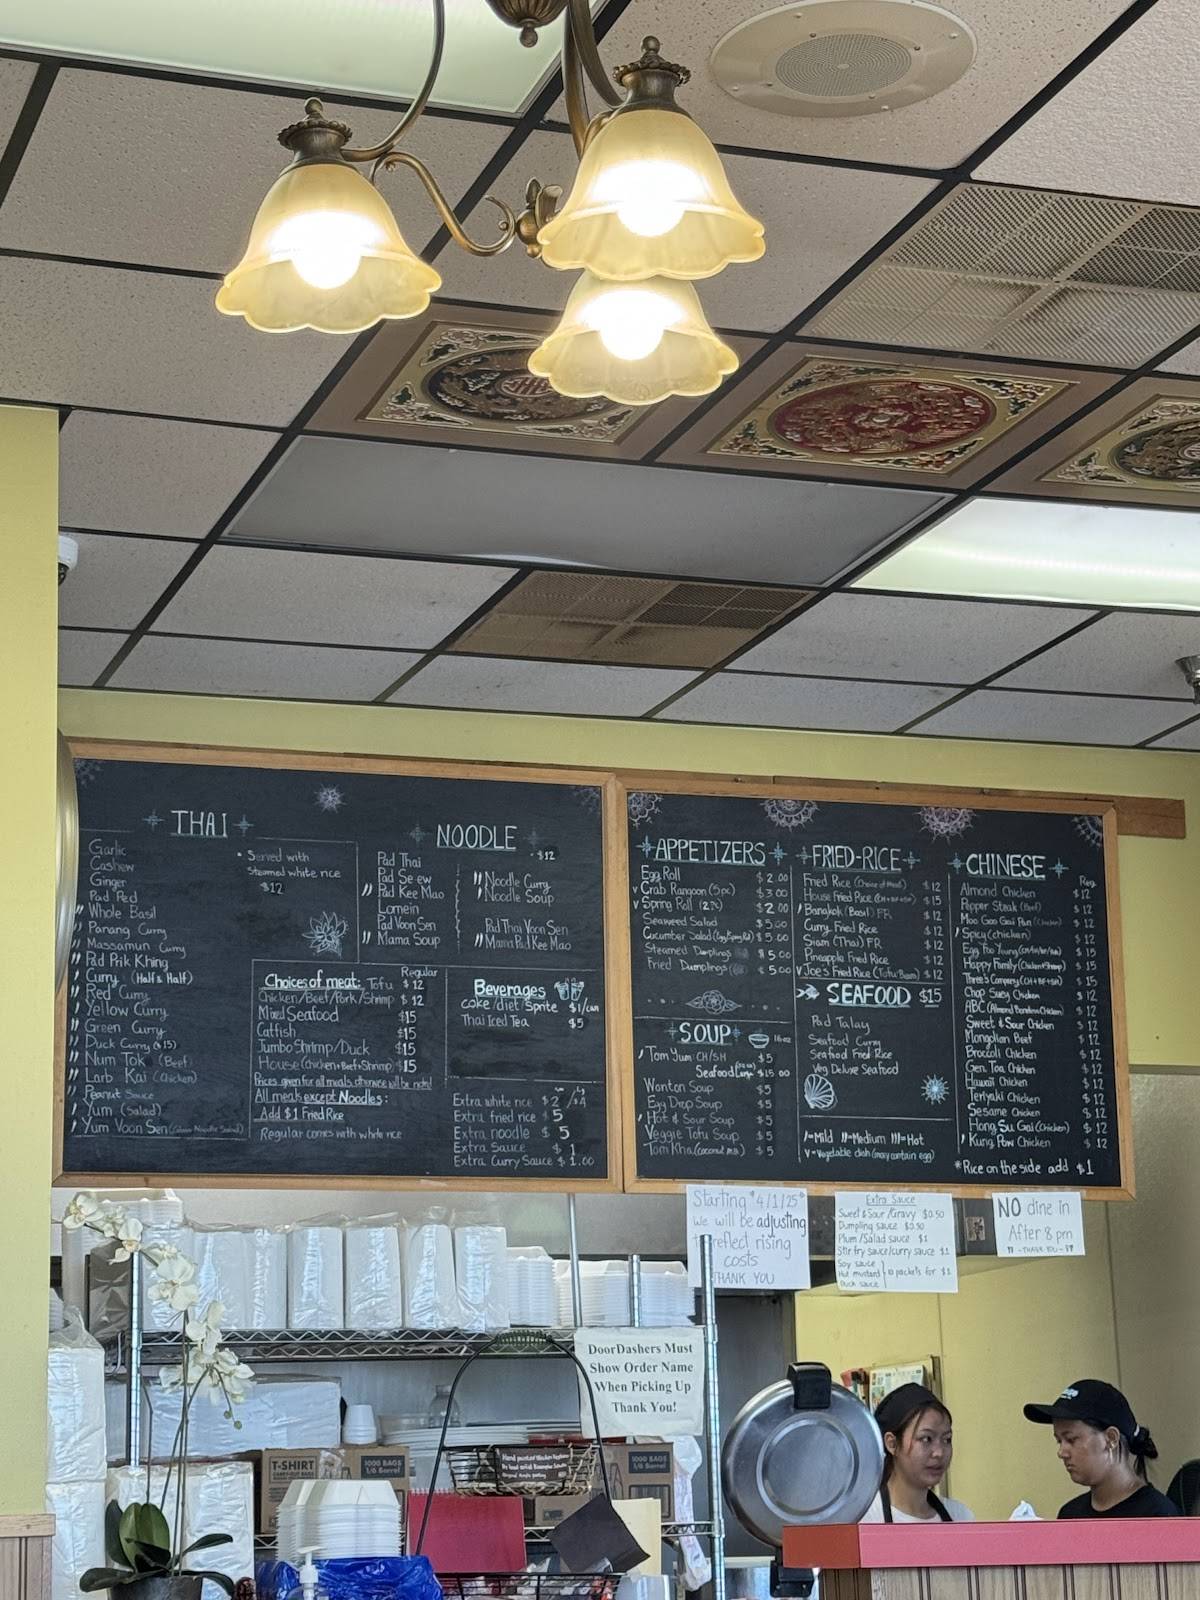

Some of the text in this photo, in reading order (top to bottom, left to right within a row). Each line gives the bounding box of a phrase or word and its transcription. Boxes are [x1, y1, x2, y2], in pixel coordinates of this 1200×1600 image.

[171, 810, 227, 837] THAI
[437, 824, 517, 849] NOODLE
[89, 838, 127, 856] Garlic
[655, 839, 766, 863] APPETIZERS
[90, 855, 135, 872] Cashew
[378, 851, 422, 868] Pad Thai
[813, 845, 901, 871] FRIED-RICE
[288, 866, 318, 878] white
[641, 865, 681, 882] Egg Roll
[966, 853, 1046, 879] CHINESE
[90, 872, 127, 892] Ginger
[378, 867, 394, 884] Pad
[485, 871, 520, 887] Noodle
[803, 873, 852, 888] Fried Rice
[378, 884, 445, 900] Pad Kee Mao
[641, 881, 666, 895] Crab
[960, 882, 1036, 898] Almond Chicken
[90, 890, 109, 903] Pad
[485, 886, 554, 906] Noodle Soup
[88, 903, 156, 920] Whole Basil
[378, 901, 419, 915] Lomein
[641, 897, 692, 912] Spring Roll
[88, 921, 130, 939] Panang
[377, 916, 436, 931] Pad Voon Sen
[804, 919, 878, 936] Curry Rice
[87, 938, 150, 951] Massamun
[377, 931, 441, 950] Mama Soup
[85, 953, 168, 972] Pad Prik Khing
[870, 952, 889, 965] Rice
[963, 958, 991, 973] Happy
[265, 970, 361, 989] Choices of meat:
[401, 966, 438, 980] Regular
[367, 977, 393, 990] Tofu
[474, 978, 546, 1000] Beverages
[85, 984, 111, 1001] Red
[827, 983, 942, 1004] SEAFOOD $15
[85, 1000, 168, 1021] Yellow Curry
[287, 1005, 338, 1023] Seafood
[461, 1014, 529, 1027] Thai Iced Tea
[811, 1015, 870, 1035] Pad Talay
[966, 1015, 996, 1030] Sweet
[85, 1019, 167, 1039] Green Curry
[257, 1022, 297, 1038] Catfish
[679, 1022, 731, 1044] SOUP
[85, 1034, 115, 1049] Duck
[85, 1052, 146, 1066] Num Tok
[645, 1046, 669, 1062] Tom
[874, 1050, 893, 1059] Rice
[1005, 1047, 1037, 1059] Chicken
[695, 1066, 734, 1078] Seafood
[831, 1063, 899, 1075] Deluxe Seafood
[644, 1078, 714, 1095] Wonton Soup
[304, 1090, 337, 1104] except
[453, 1092, 481, 1107] Extra
[696, 1097, 722, 1112] Soup
[1007, 1092, 1040, 1104] Chicken
[83, 1099, 113, 1117] Yum
[260, 1107, 344, 1120] Add Rice
[490, 1109, 536, 1122] fried rice
[967, 1103, 1007, 1117] Sesame
[82, 1121, 143, 1134] Yum Voon
[709, 1113, 735, 1127] Soup
[1000, 1120, 1015, 1133] Su
[260, 1127, 303, 1141] Regular
[453, 1126, 530, 1140] Extra noodle
[645, 1124, 739, 1143] Veggie Soup
[453, 1141, 487, 1153] Extra
[453, 1155, 552, 1169] Extra Curry Sauce
[986, 1159, 1069, 1175] on the side add
[693, 1189, 746, 1213] Starting
[866, 1194, 887, 1205] Extra
[998, 1197, 1070, 1218] NO dine in
[715, 1212, 734, 1227] will
[740, 1211, 753, 1227] be
[757, 1212, 806, 1237] adjusting
[1009, 1224, 1073, 1244] After 8 pm
[756, 1235, 791, 1260] rising
[723, 1250, 759, 1268] costs
[754, 1272, 774, 1284] YOU
[588, 1343, 693, 1355] DoorDashers Must
[590, 1361, 694, 1373] Show Order Name
[594, 1381, 692, 1394] When Picking Up
[612, 1402, 677, 1413] Thank You!
[272, 1460, 314, 1471] T-SHIRT
